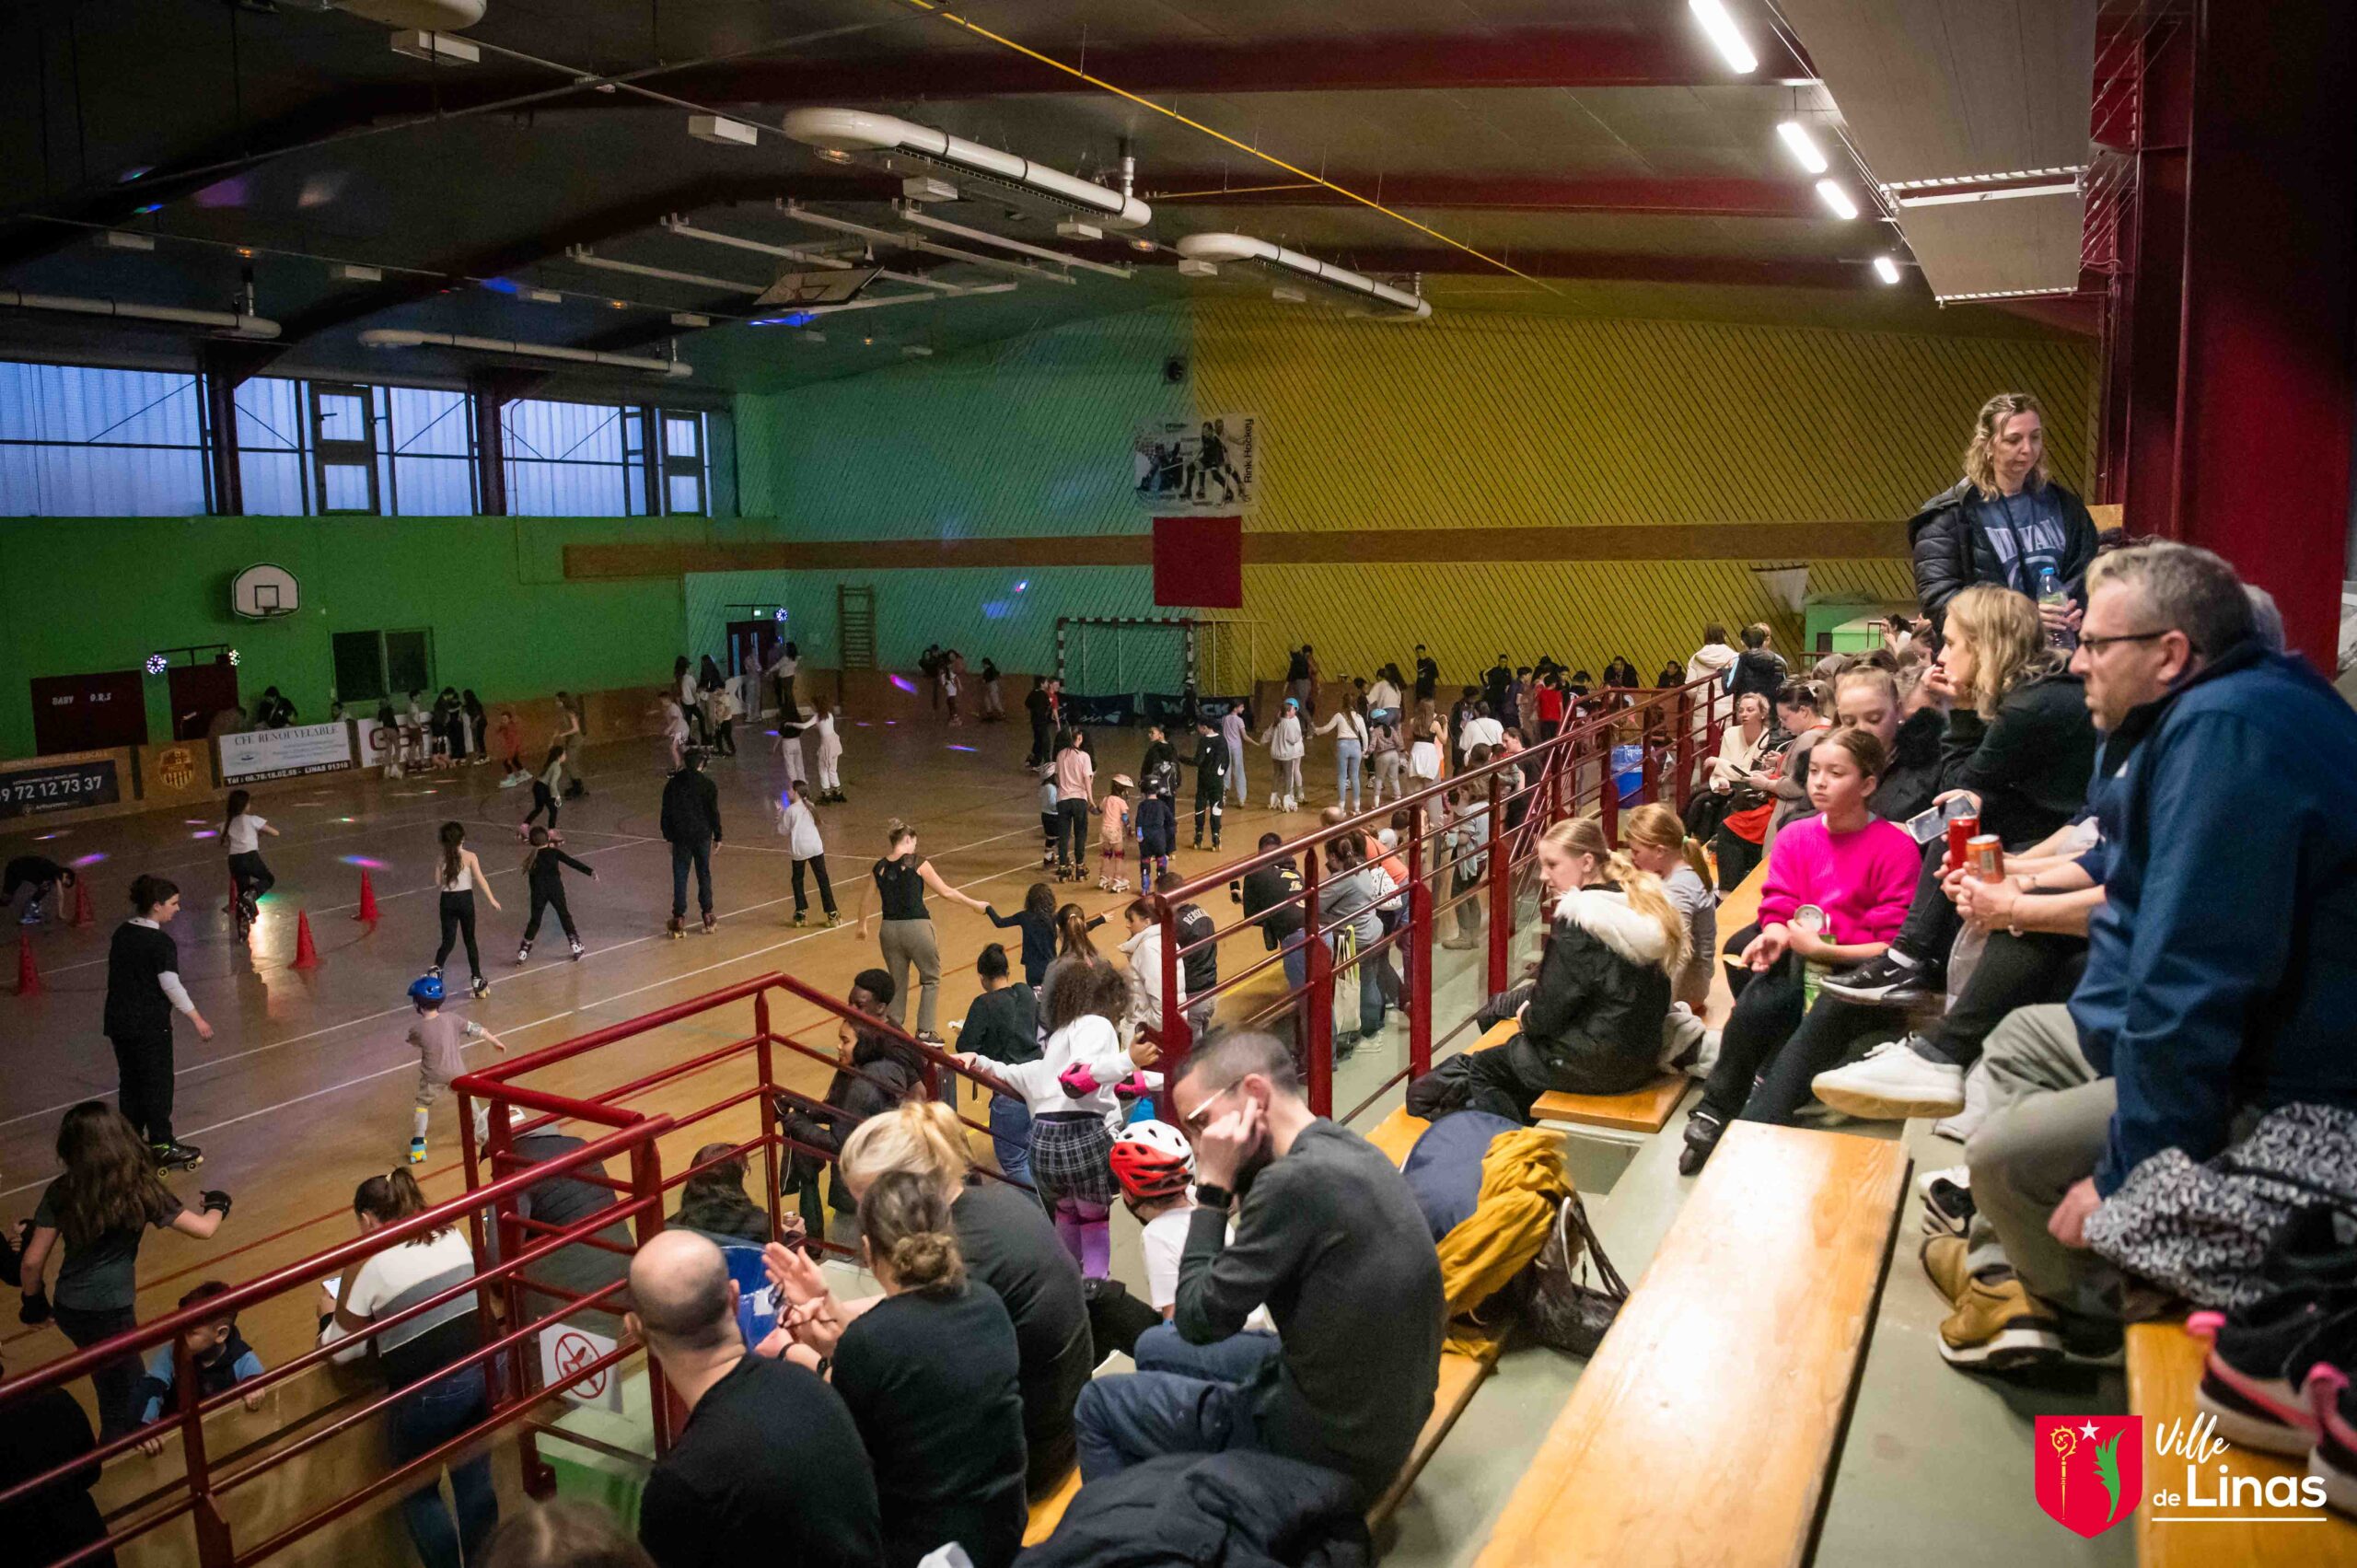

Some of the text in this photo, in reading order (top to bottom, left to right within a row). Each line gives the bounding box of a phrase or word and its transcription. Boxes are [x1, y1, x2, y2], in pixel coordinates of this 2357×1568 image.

[1244, 419, 1254, 483] Rink Hockey
[52, 695, 74, 706] BABY
[304, 764, 326, 773] LINAS
[0, 788, 10, 802] 9
[15, 784, 35, 800] 72
[40, 782, 58, 796] 12
[62, 779, 80, 794] 73
[84, 775, 102, 791] 37
